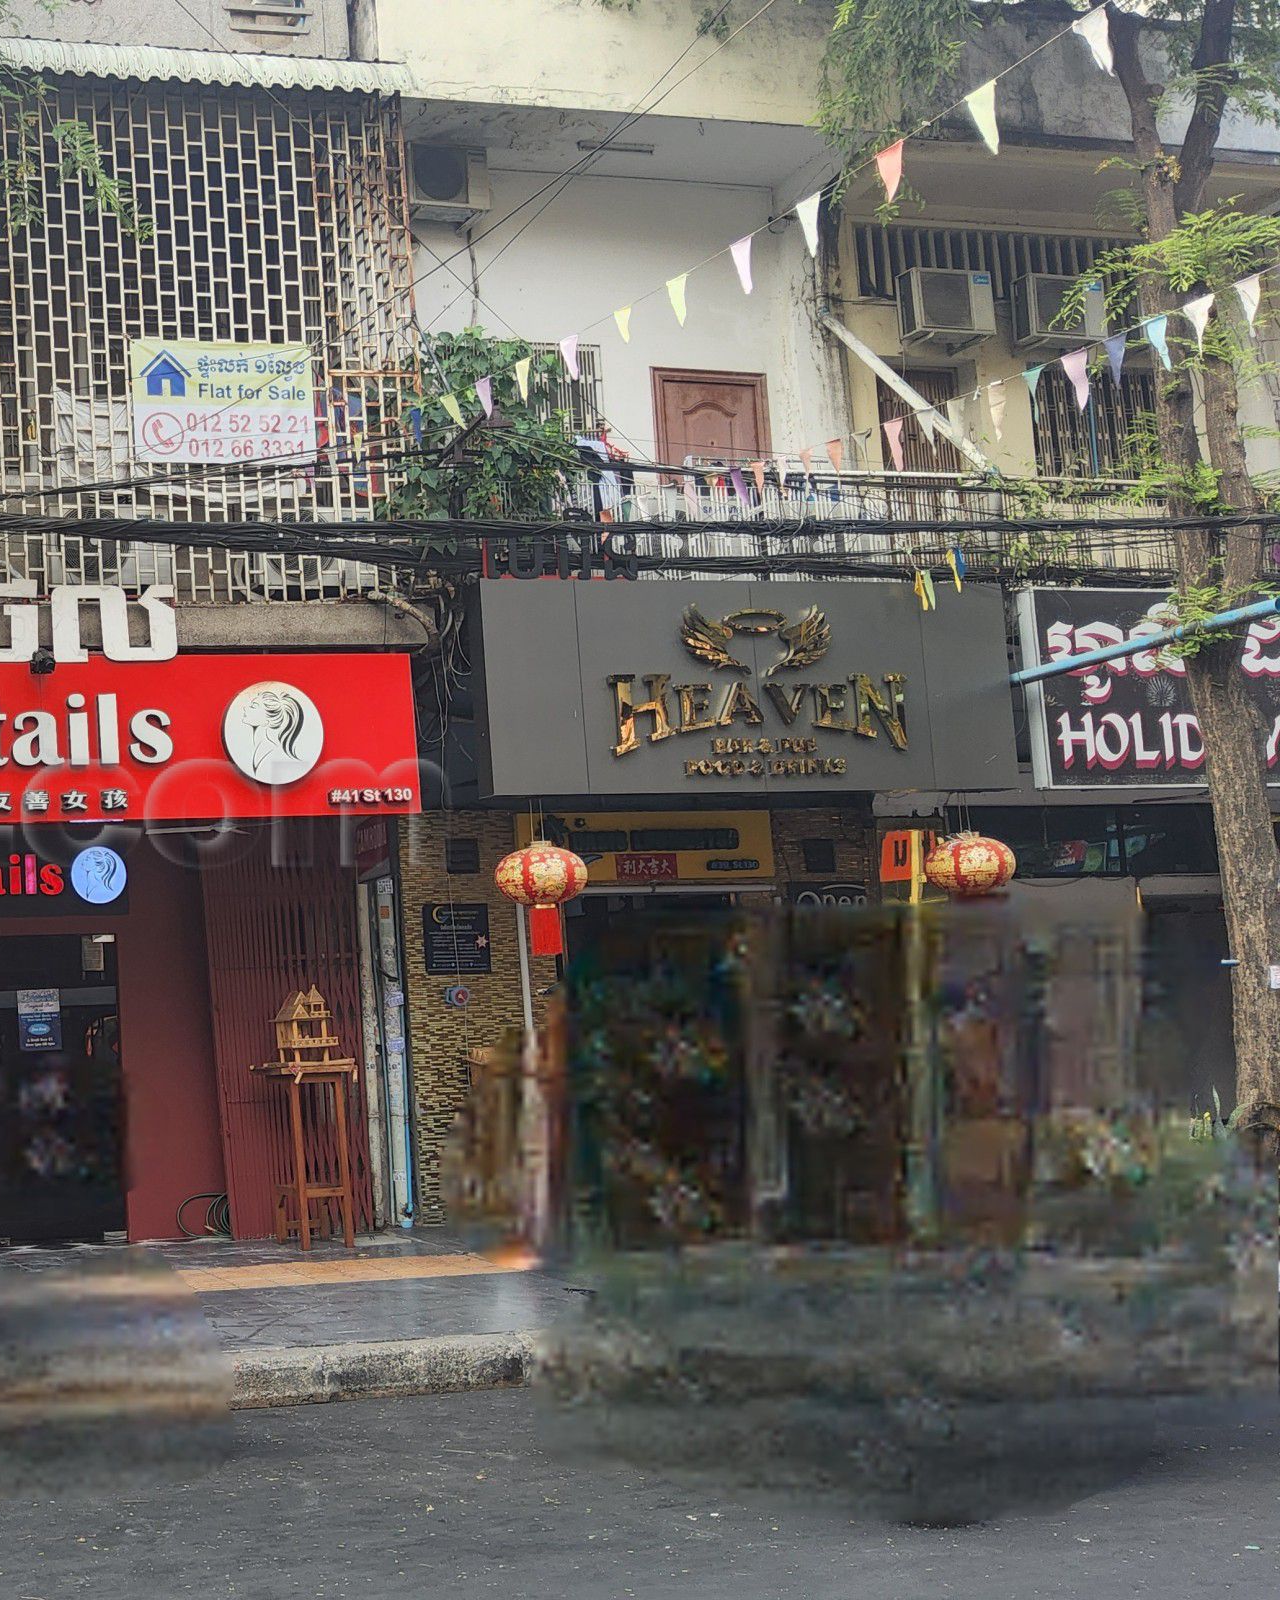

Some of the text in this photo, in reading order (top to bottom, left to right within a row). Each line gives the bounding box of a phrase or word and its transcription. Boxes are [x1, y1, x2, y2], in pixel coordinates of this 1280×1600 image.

[198, 383, 306, 401] Flat for Sale
[186, 412, 308, 434] 012 52 52 21
[188, 438, 224, 458] 012
[231, 439, 254, 458] 66
[607, 672, 908, 756] HEAVEN
[710, 737, 754, 755] BAR
[755, 737, 773, 754] &
[683, 759, 746, 777] FOOD
[769, 758, 848, 776] DRINKS
[331, 787, 413, 803] #41 St 130
